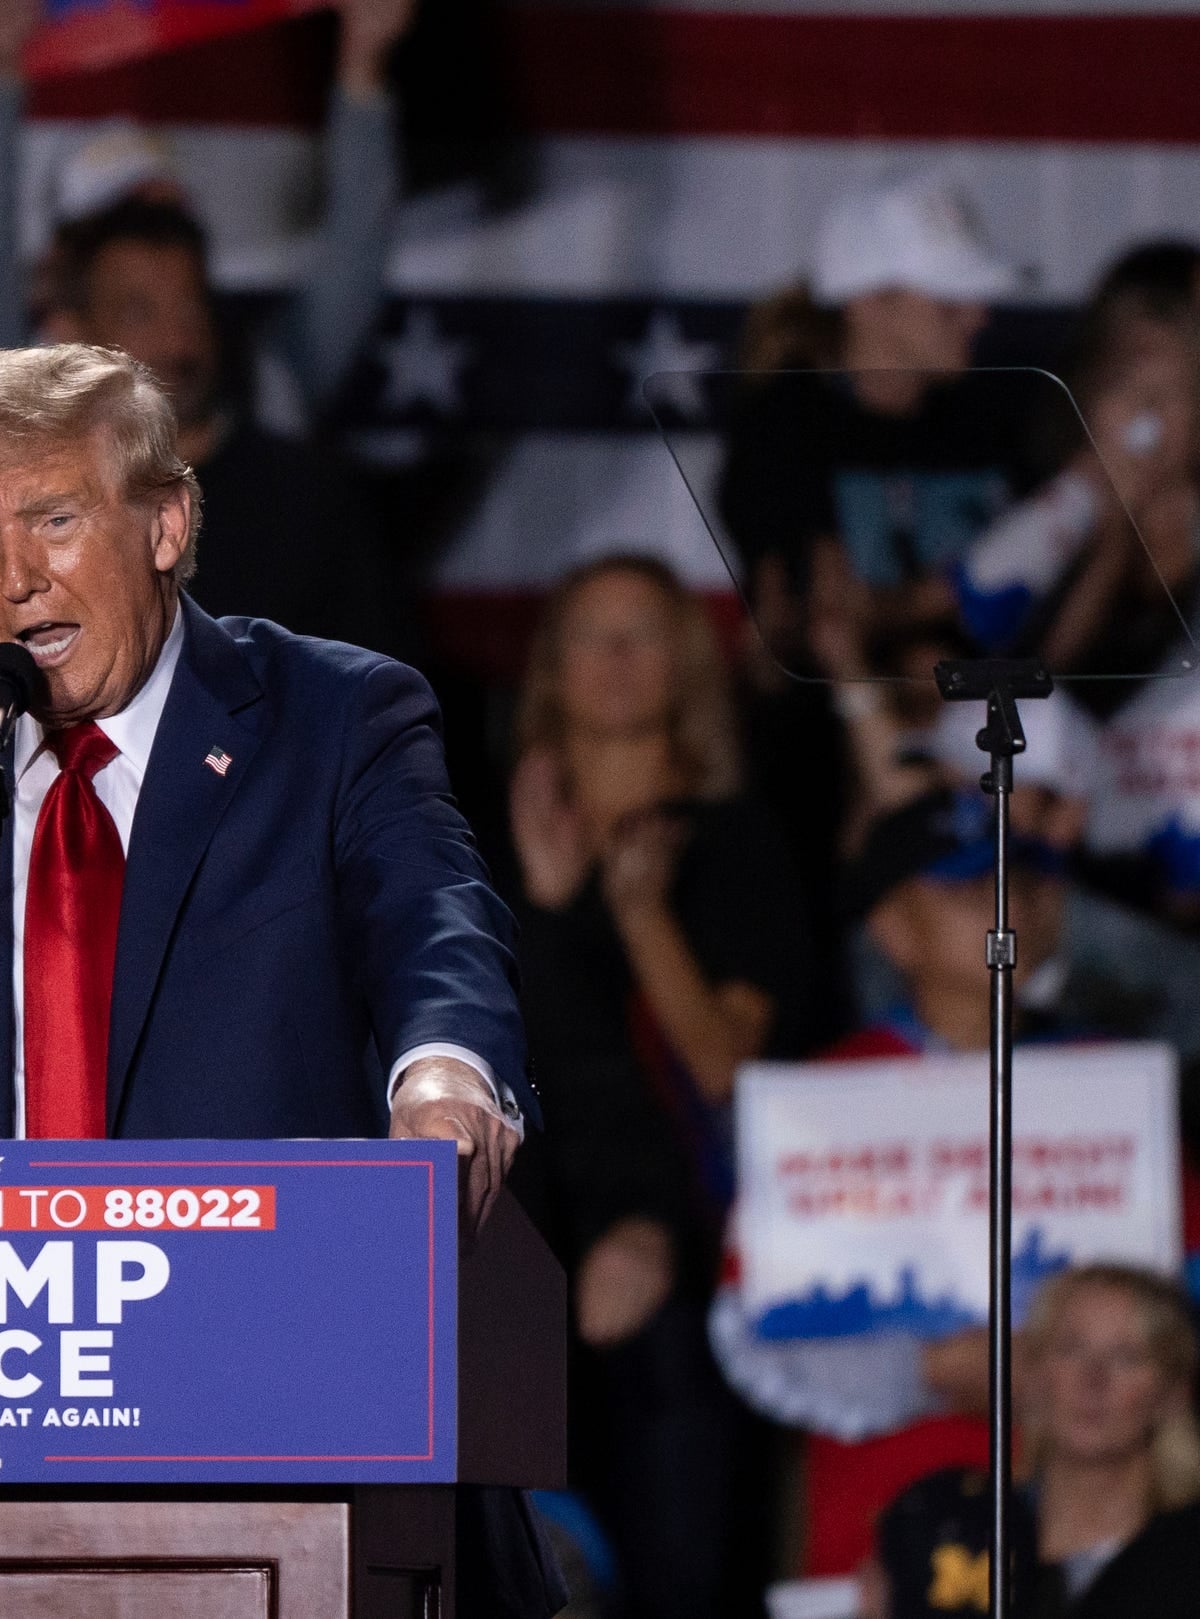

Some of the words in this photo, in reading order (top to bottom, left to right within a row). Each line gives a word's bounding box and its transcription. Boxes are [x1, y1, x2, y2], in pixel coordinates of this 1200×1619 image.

[19, 1189, 87, 1229] TO
[103, 1188, 261, 1228] 88022
[42, 1407, 140, 1428] AGAIN!
